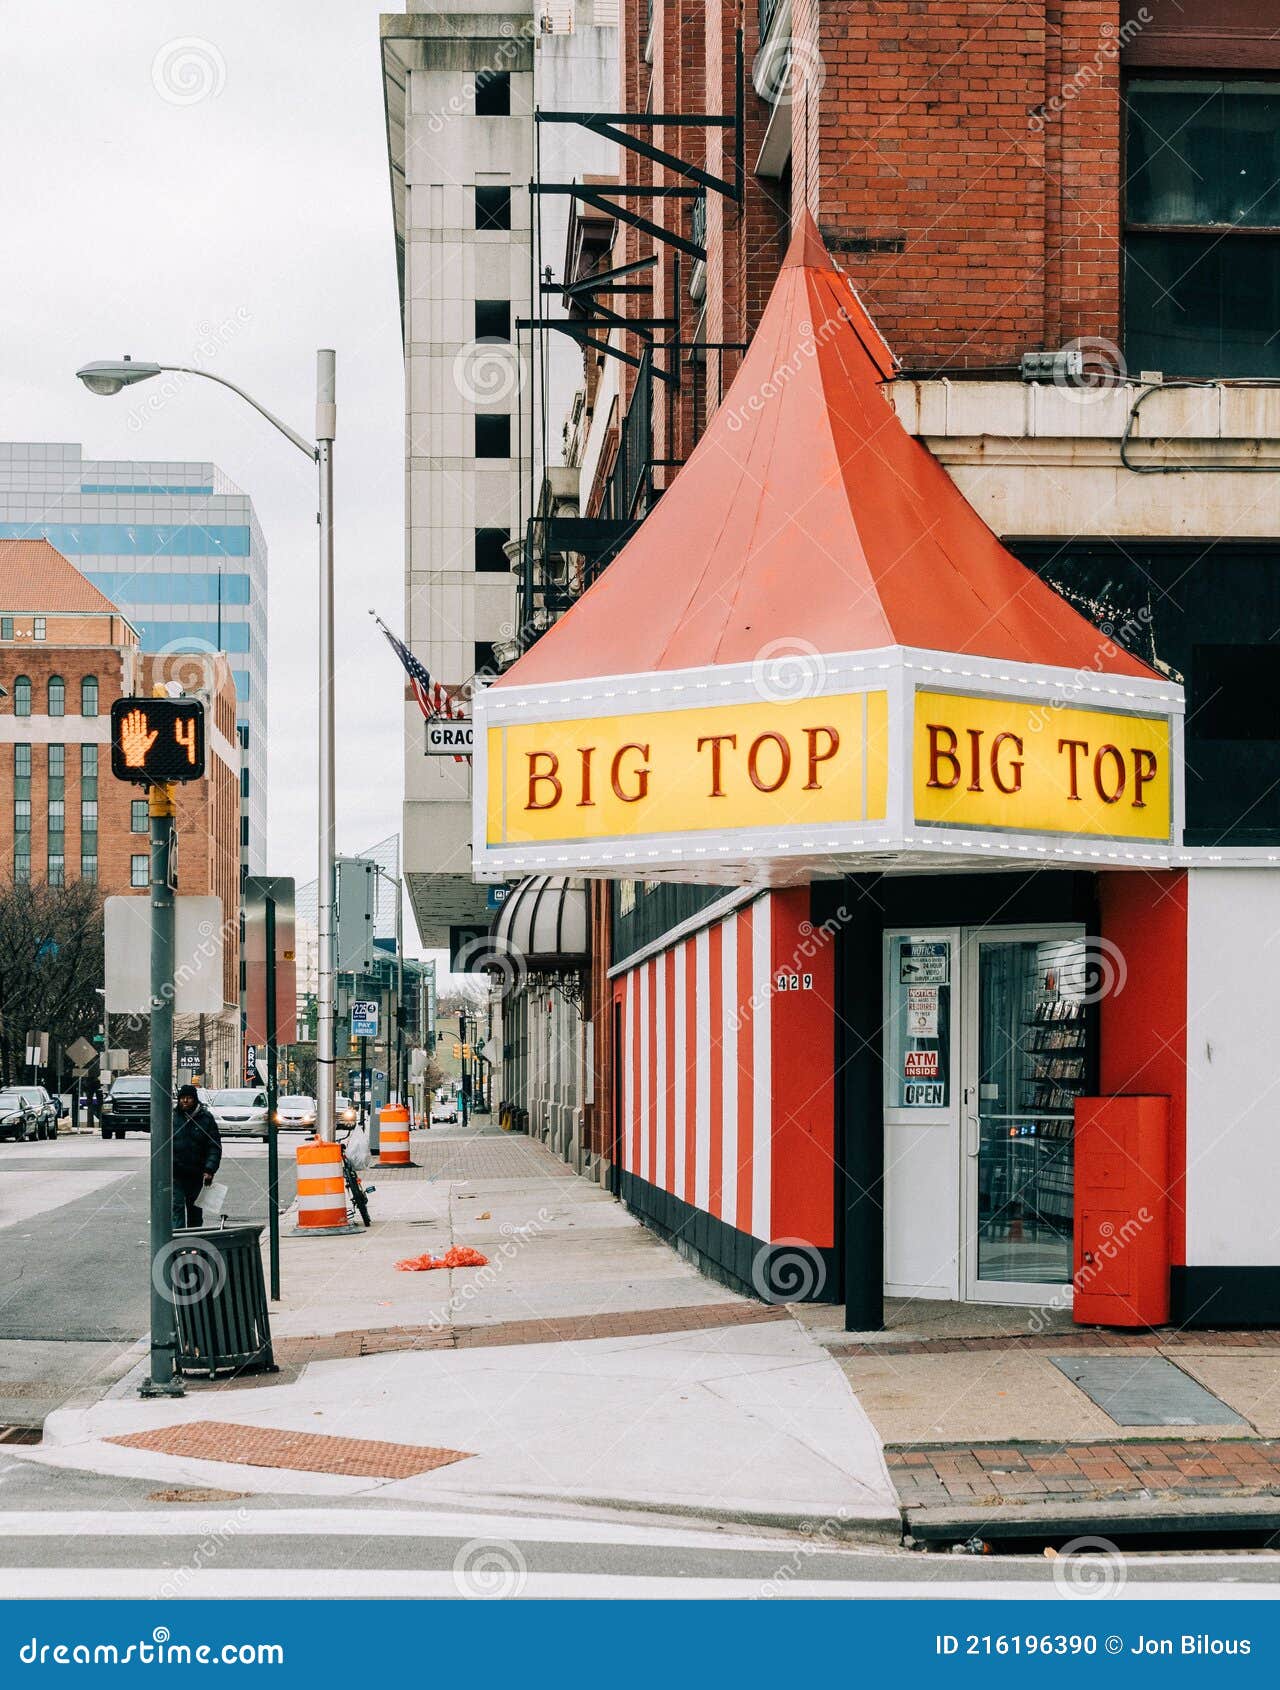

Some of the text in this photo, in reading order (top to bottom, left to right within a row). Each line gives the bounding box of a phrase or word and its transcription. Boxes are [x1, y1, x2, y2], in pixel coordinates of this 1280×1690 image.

[175, 717, 196, 765] 4
[523, 726, 840, 811] BIG TOP
[926, 724, 1158, 808] BIG TOP
[911, 945, 936, 955] NOTICE
[778, 975, 811, 990] 429
[909, 989, 936, 997] NOTICE
[906, 1053, 936, 1066] ATM
[906, 1067, 937, 1075] INSIDE
[905, 1084, 942, 1104] OPEN
